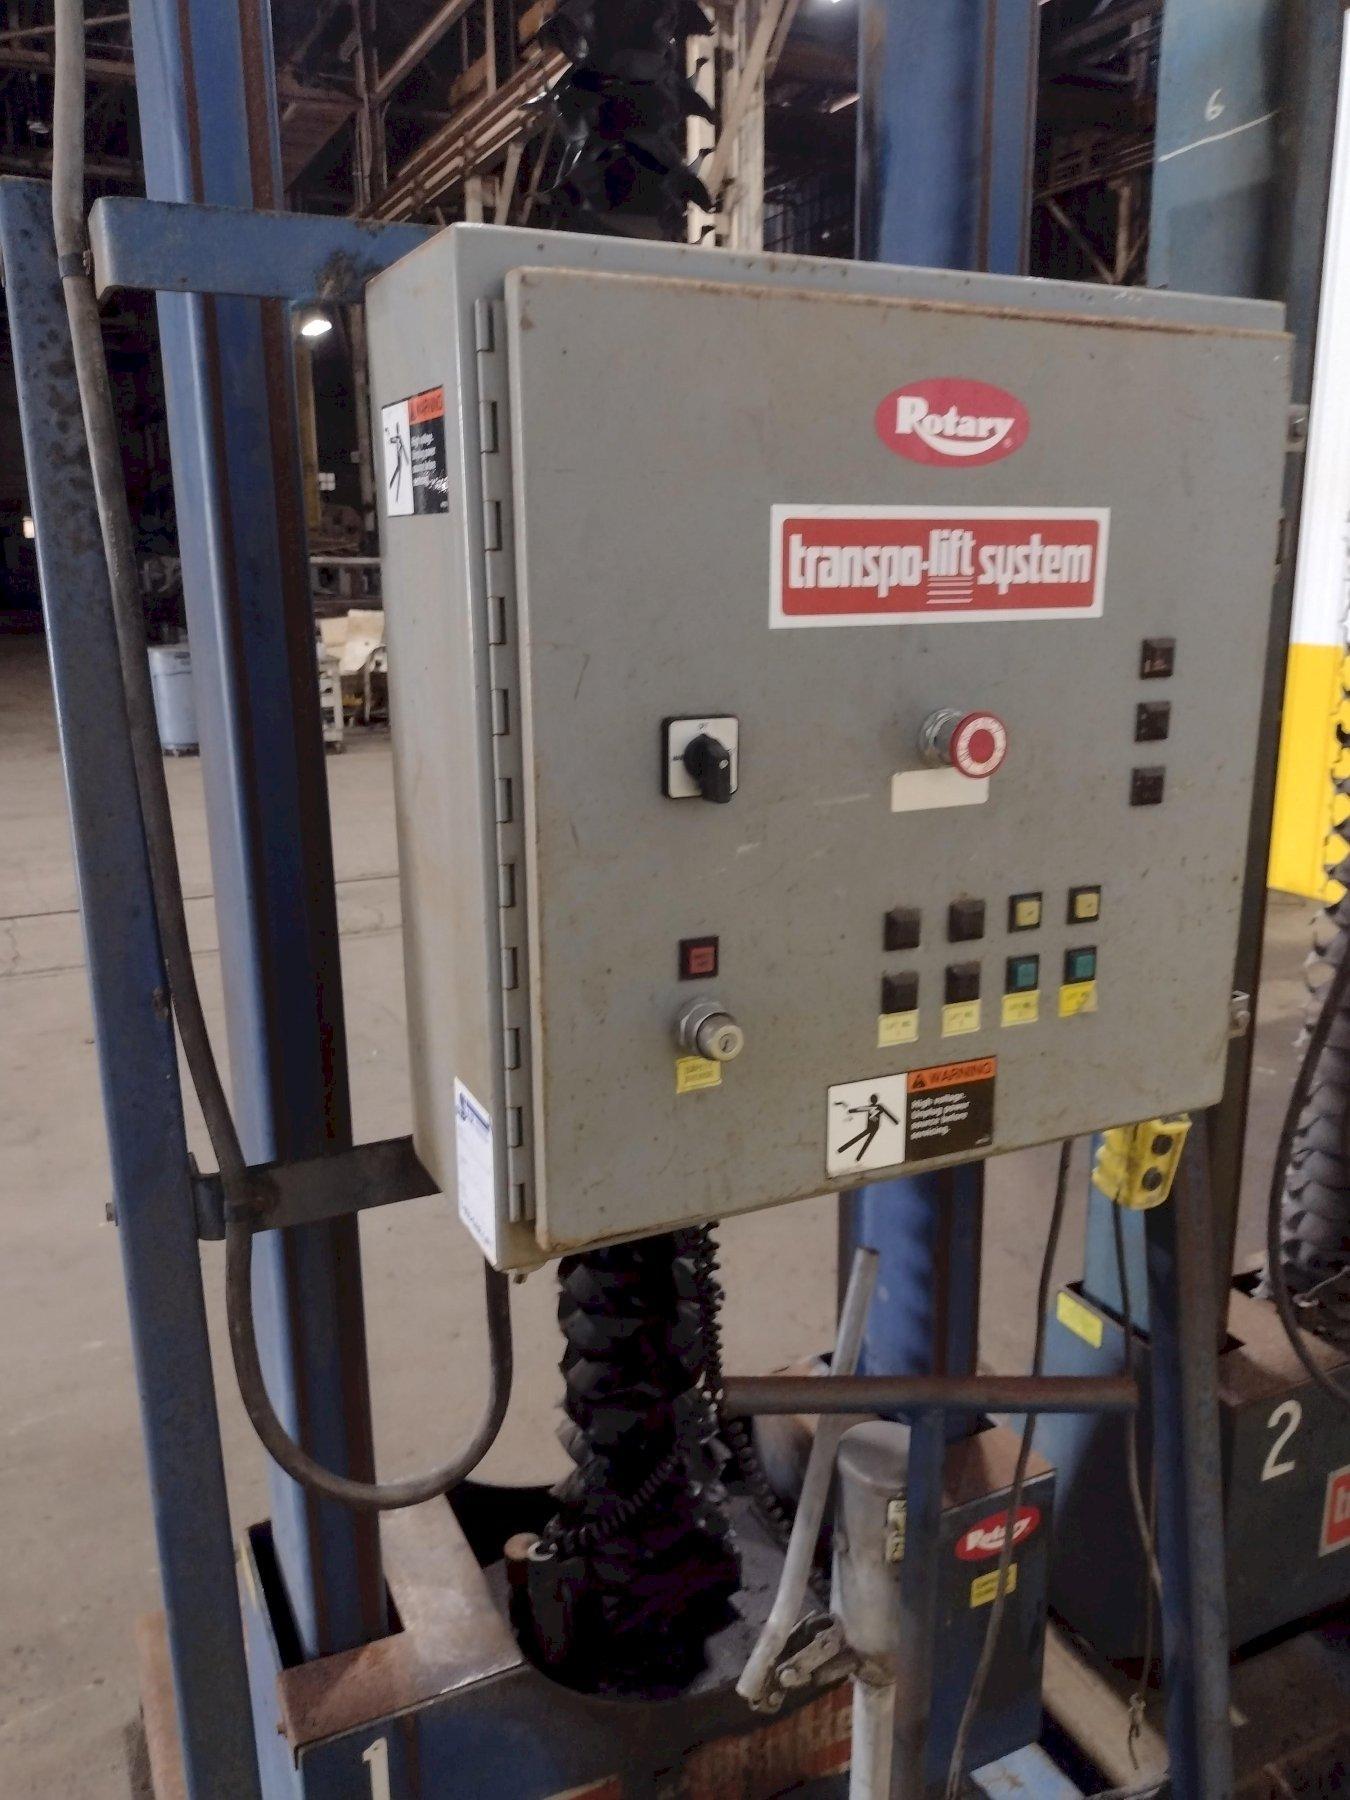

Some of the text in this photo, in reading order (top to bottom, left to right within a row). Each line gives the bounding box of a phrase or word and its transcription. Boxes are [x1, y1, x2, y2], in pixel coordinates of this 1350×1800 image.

[1204, 88, 1226, 122] 6
[894, 395, 1016, 456] Rotary
[977, 532, 1094, 595] system
[1260, 1398, 1303, 1482] 2
[361, 1736, 391, 1800] 1
